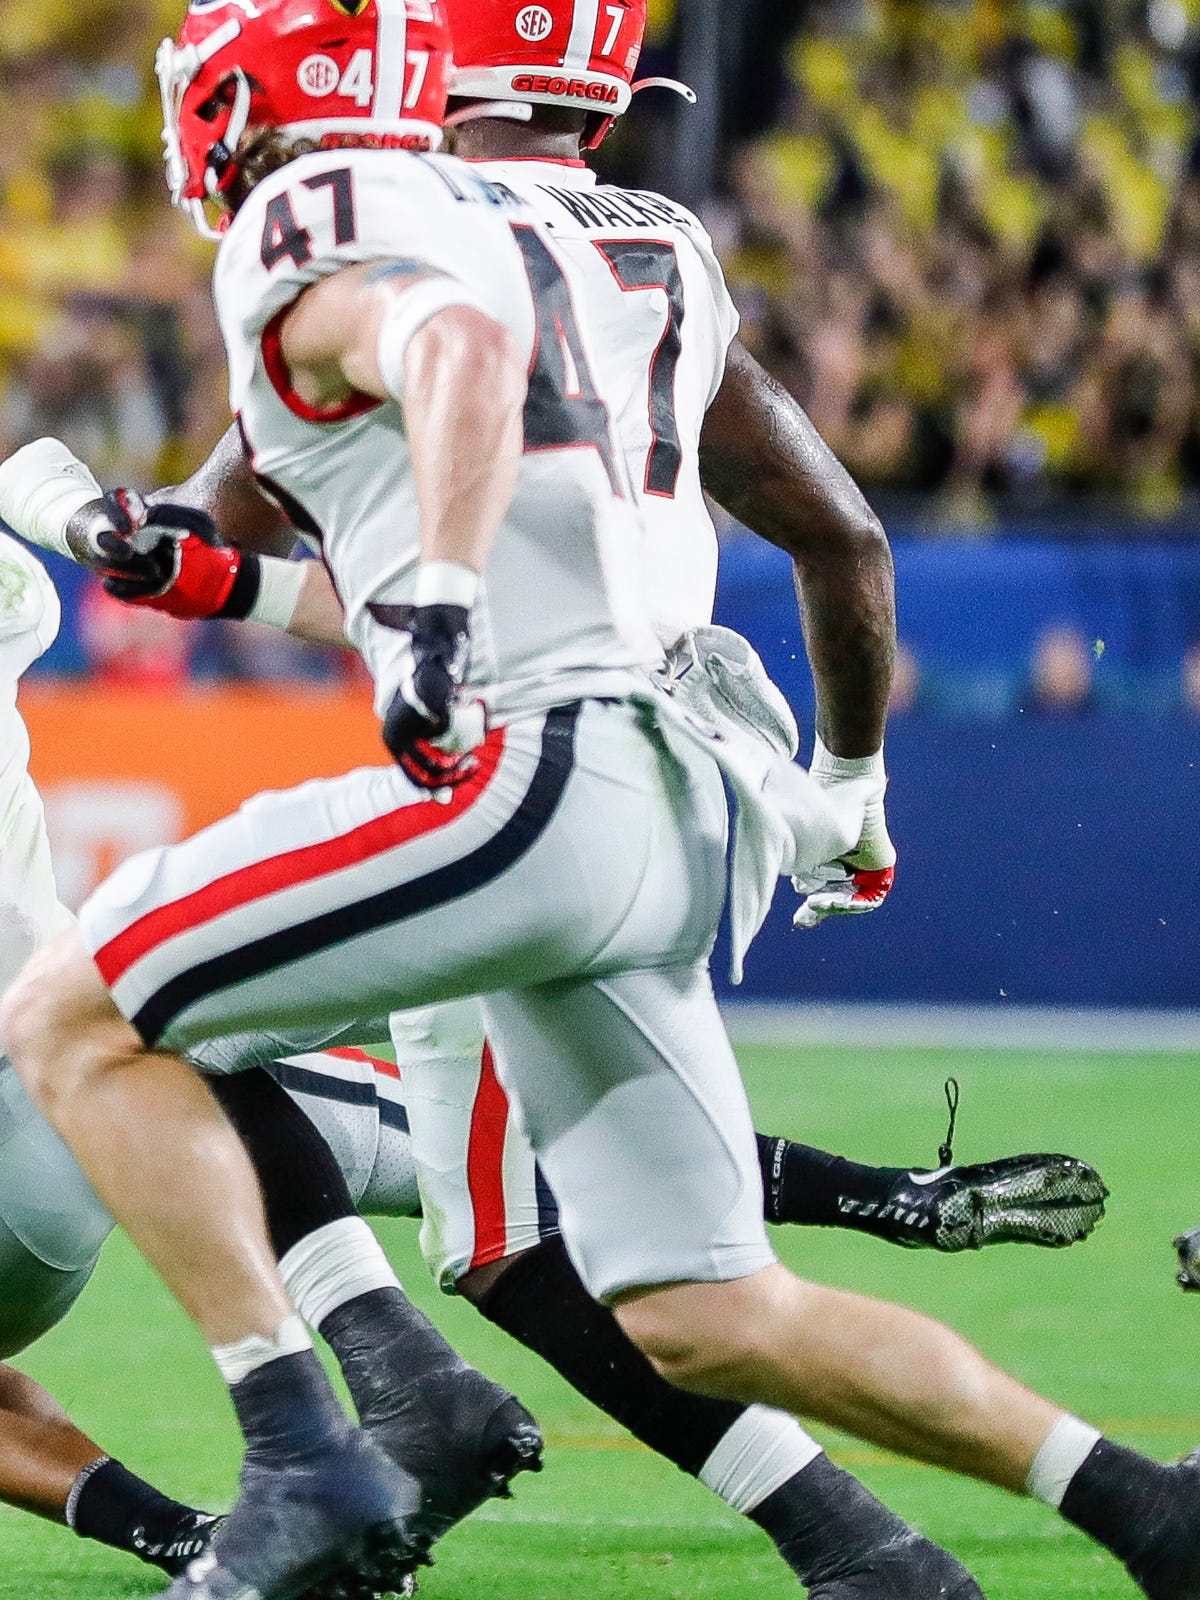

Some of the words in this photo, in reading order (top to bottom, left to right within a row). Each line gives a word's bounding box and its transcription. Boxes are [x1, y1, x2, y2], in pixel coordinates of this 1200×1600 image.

[521, 10, 548, 37] SEC
[601, 5, 625, 56] 7
[511, 74, 619, 103] GEORGIA
[260, 167, 355, 271] 47
[534, 184, 698, 229] WALKE
[590, 238, 685, 499] 7
